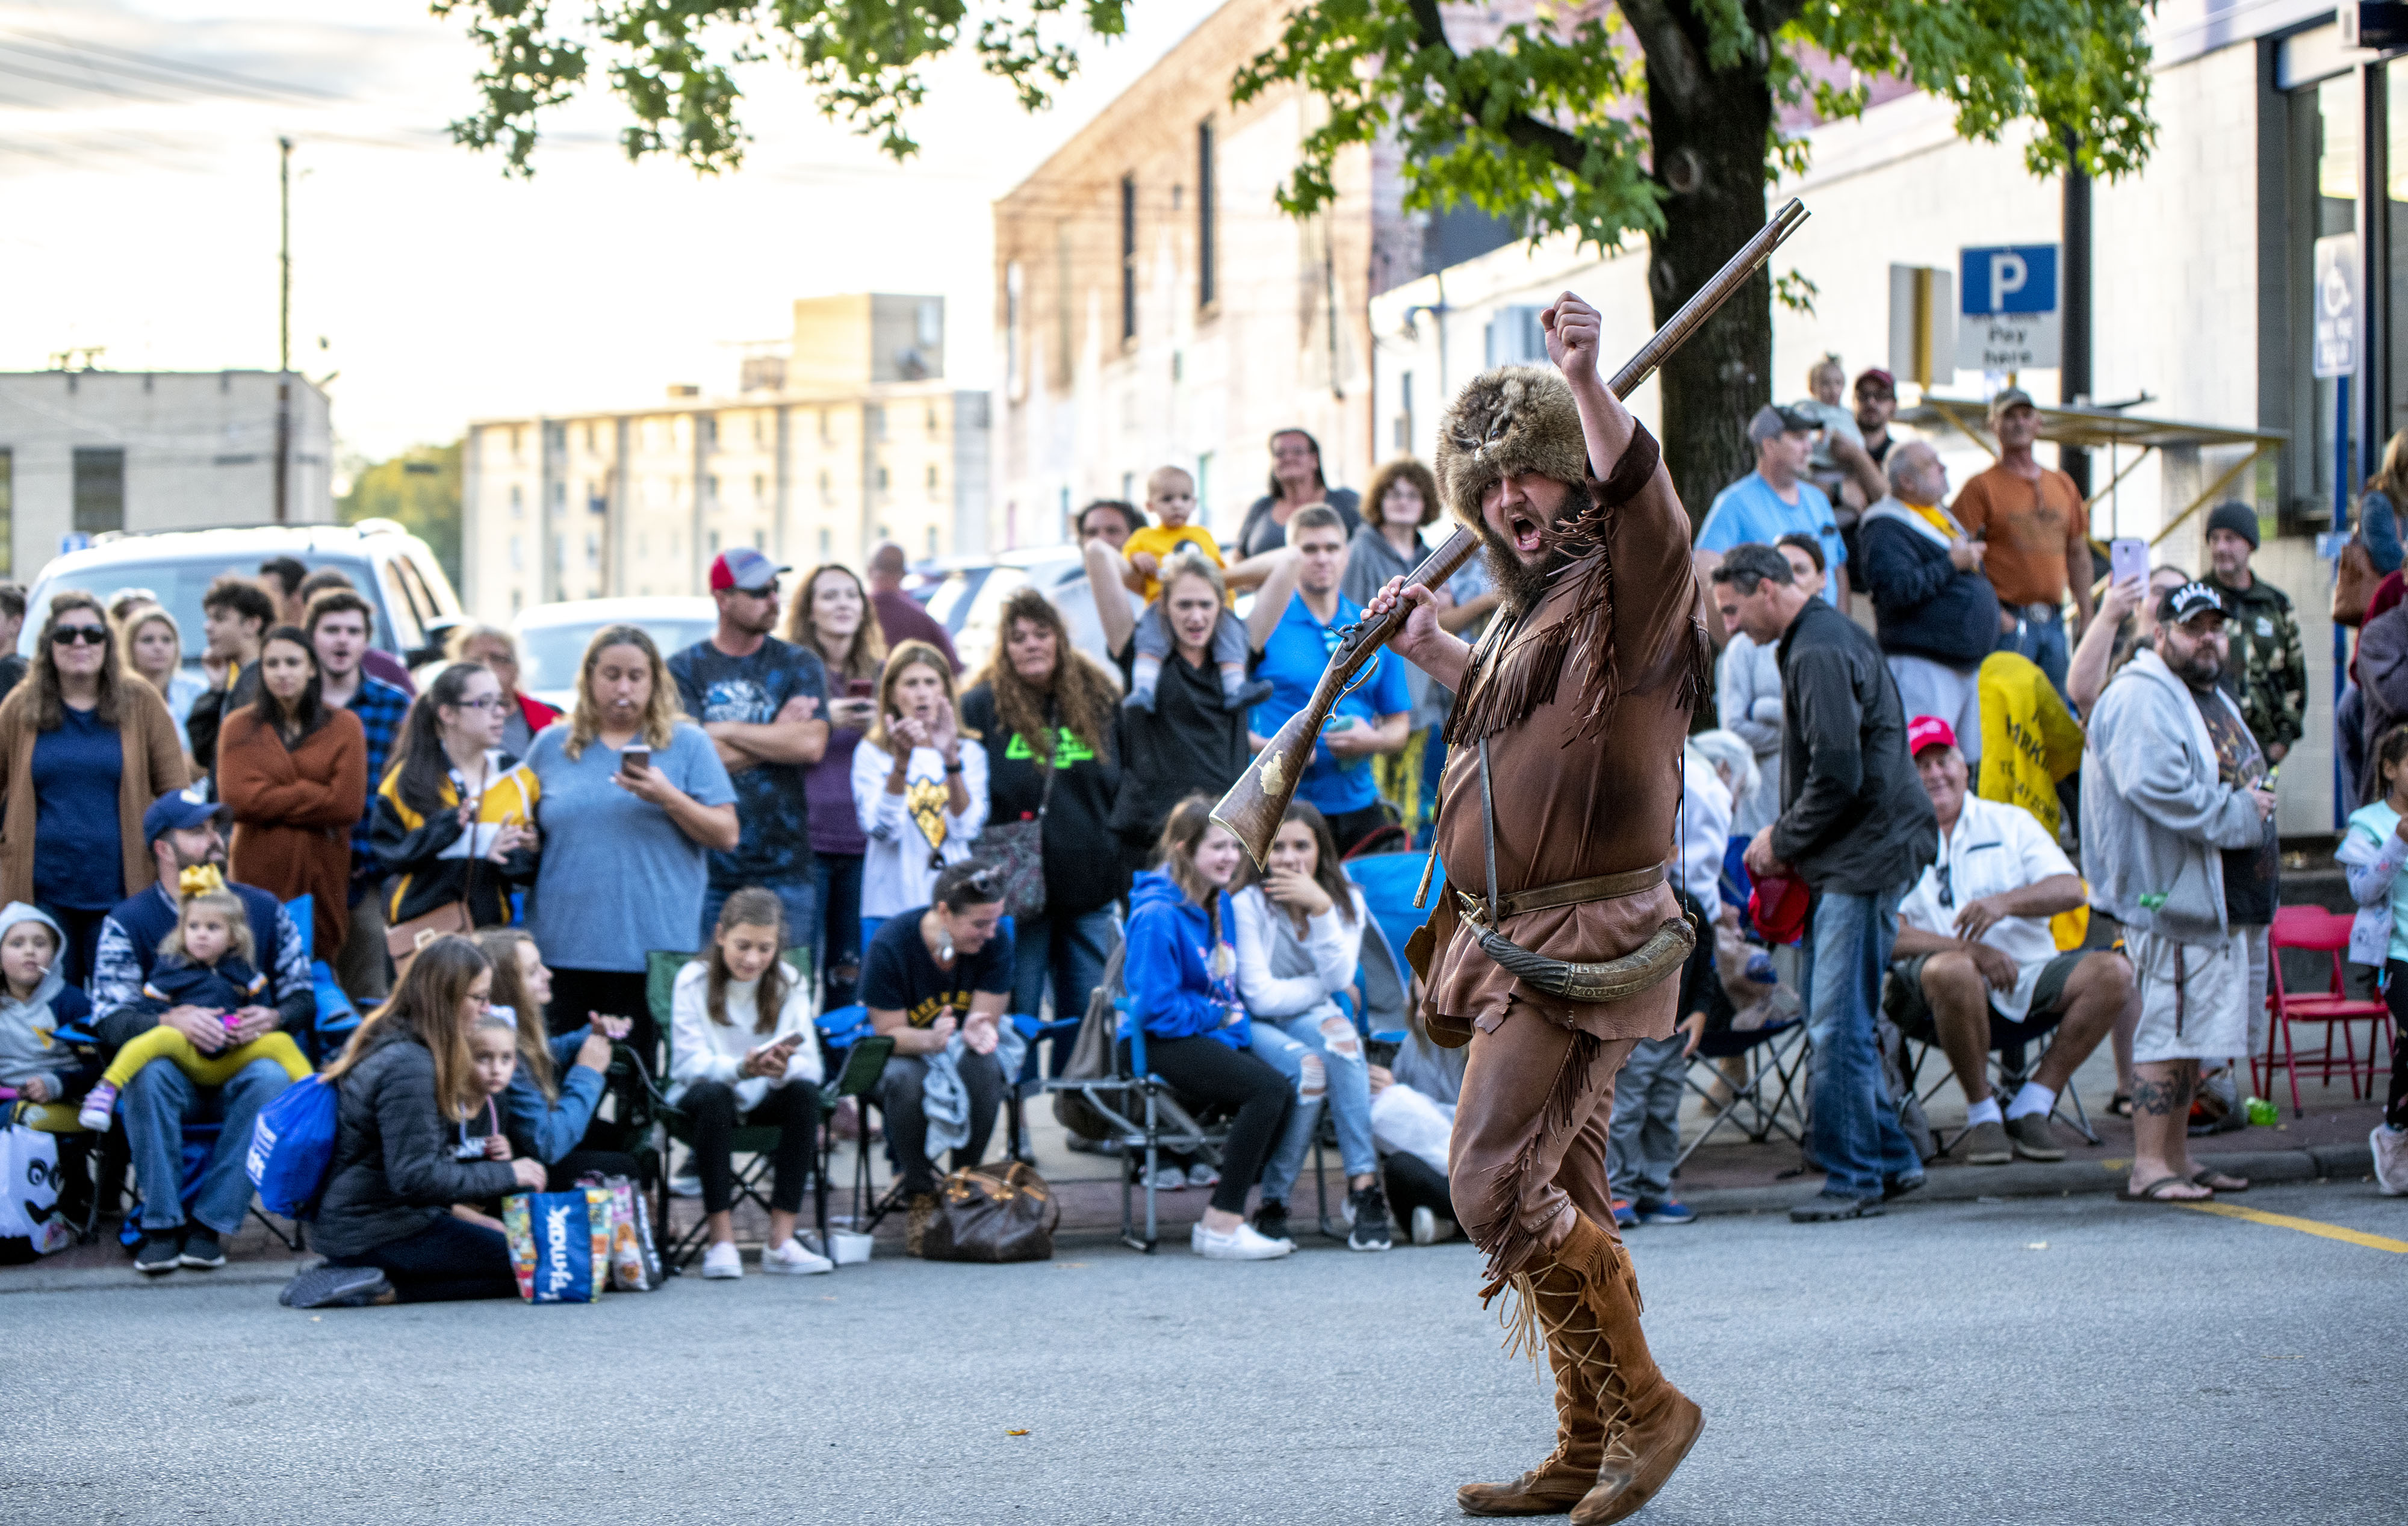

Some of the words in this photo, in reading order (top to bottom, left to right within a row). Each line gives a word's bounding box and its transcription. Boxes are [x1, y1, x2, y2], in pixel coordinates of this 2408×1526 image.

[1989, 252, 2028, 313] P
[1988, 326, 2028, 345] Pay
[1983, 347, 2032, 365] here
